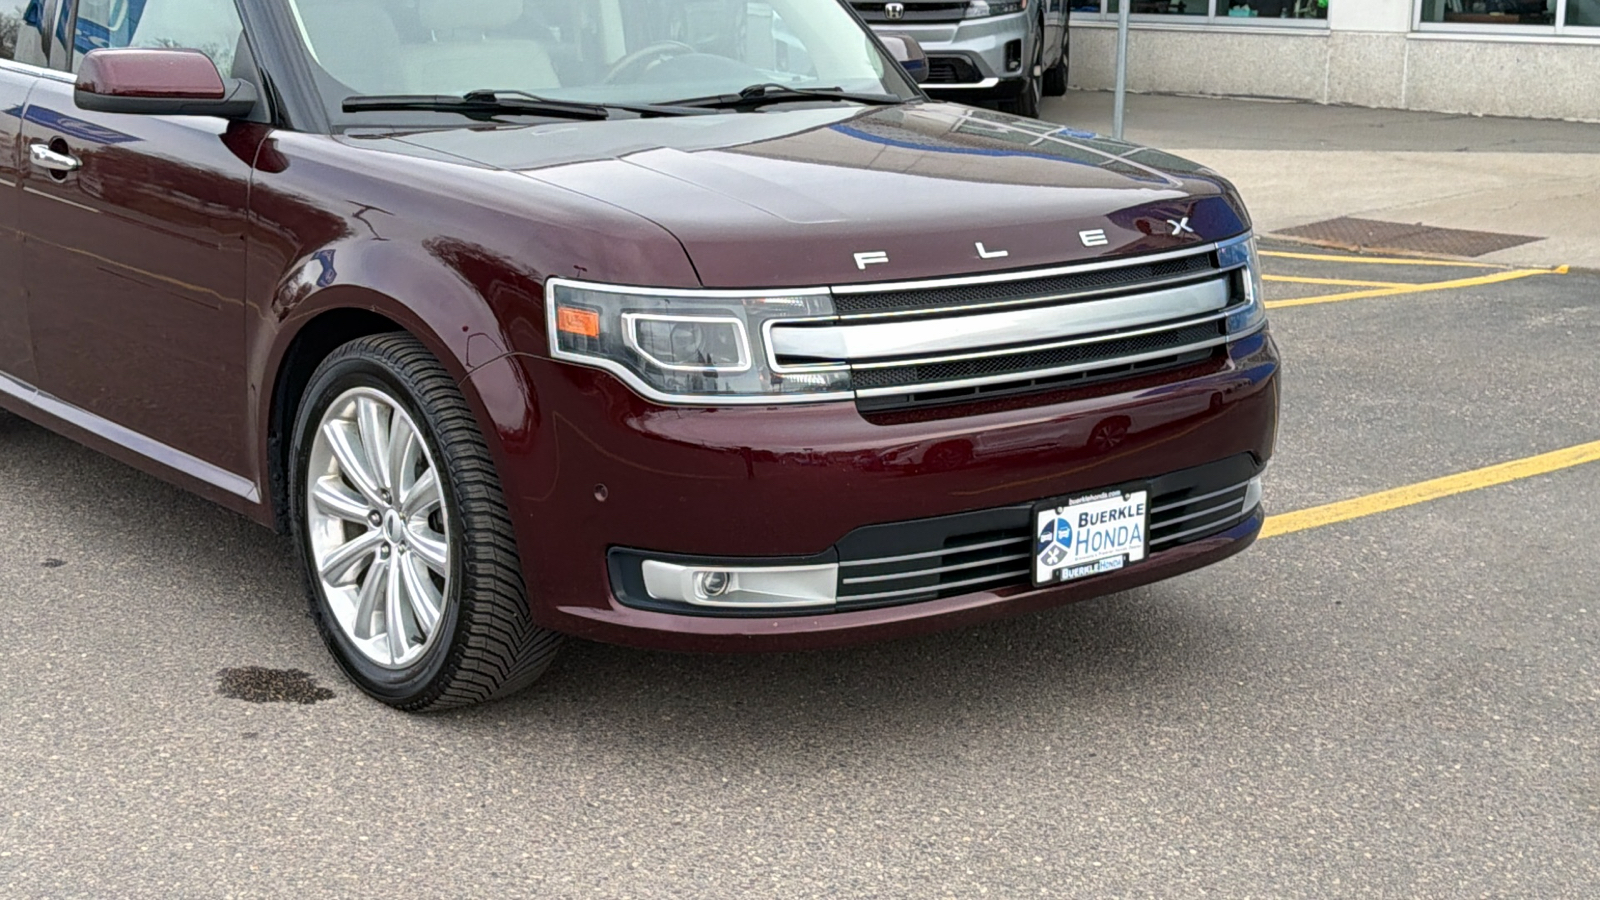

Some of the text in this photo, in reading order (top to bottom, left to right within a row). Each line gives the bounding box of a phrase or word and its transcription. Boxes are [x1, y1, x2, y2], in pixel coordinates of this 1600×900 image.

[853, 217, 1194, 270] FLEX
[1077, 503, 1145, 528] BUERKLE
[1075, 523, 1142, 556] HONDA
